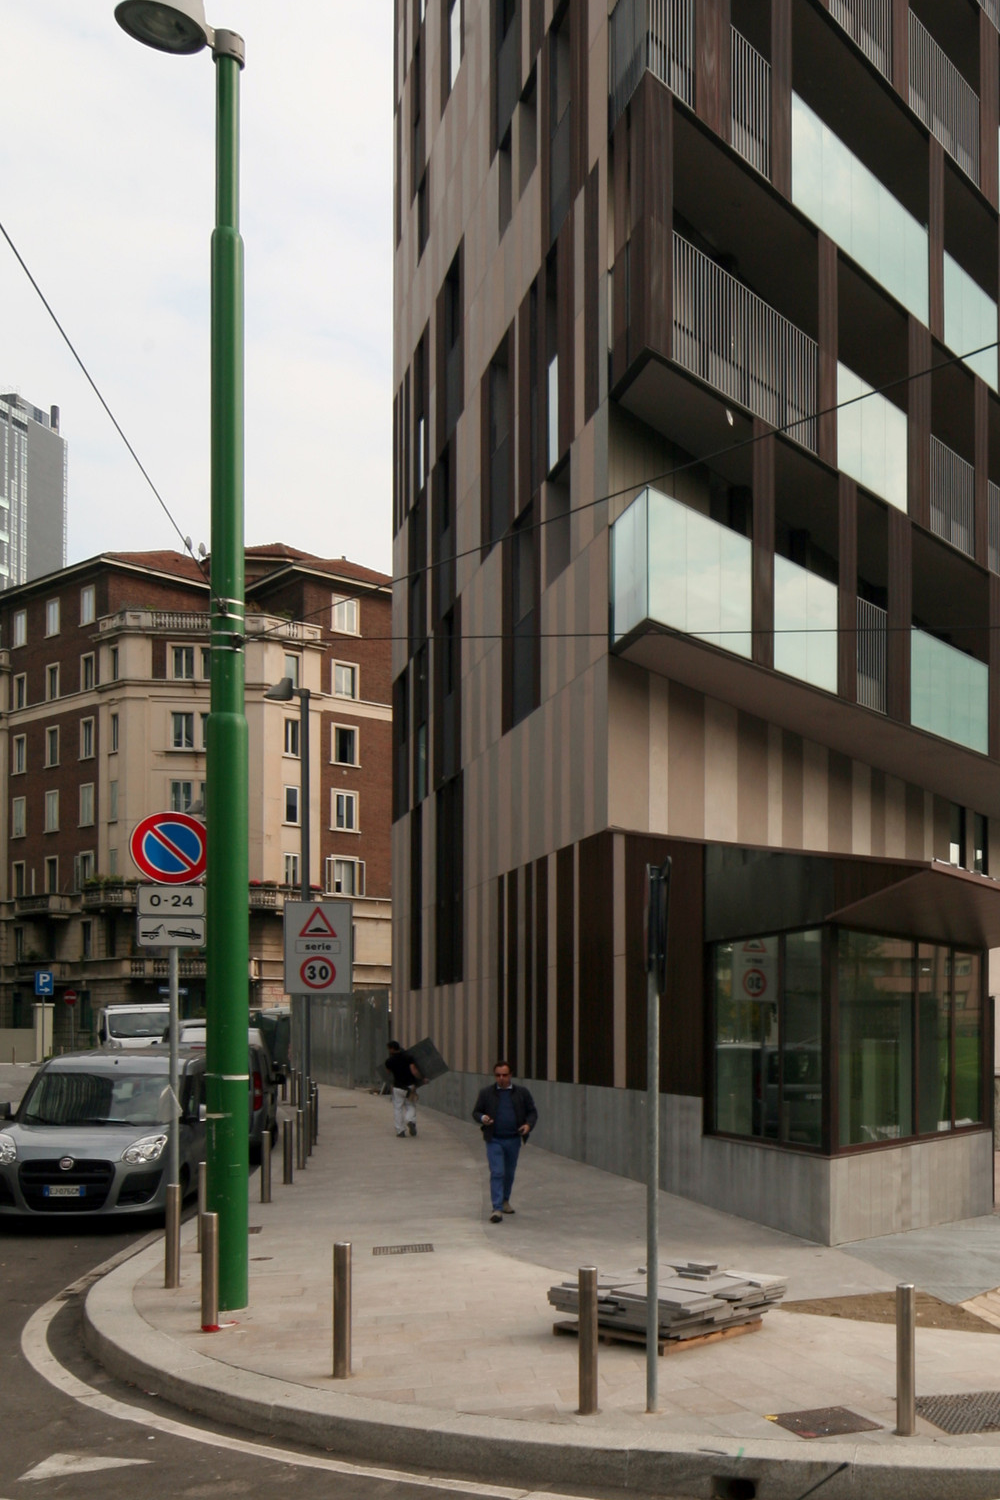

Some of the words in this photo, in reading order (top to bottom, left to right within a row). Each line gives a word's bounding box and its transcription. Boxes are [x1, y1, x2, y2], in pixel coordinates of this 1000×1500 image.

[150, 894, 193, 907] 0-24
[305, 942, 331, 951] serie
[307, 965, 329, 980] 30
[39, 973, 50, 986] P
